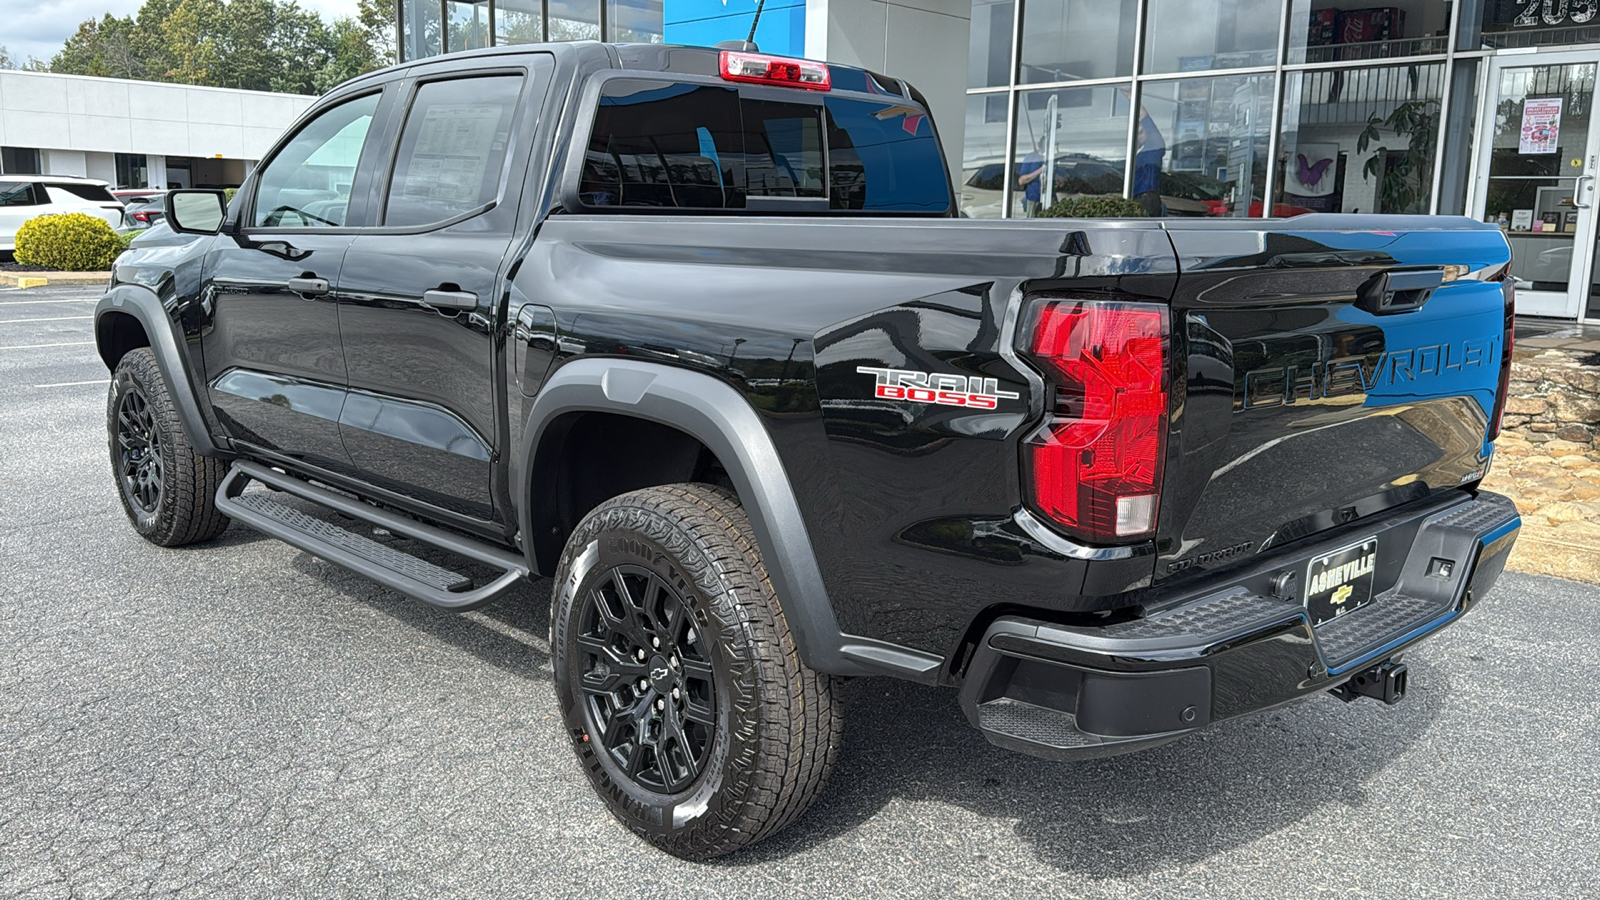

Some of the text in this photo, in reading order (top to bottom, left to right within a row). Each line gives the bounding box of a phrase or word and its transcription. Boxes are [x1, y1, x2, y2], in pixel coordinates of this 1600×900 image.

[856, 366, 1019, 400] TRAIL
[1244, 334, 1500, 410] CHEVROLET
[875, 385, 998, 410] BOSS
[1167, 541, 1254, 573] COLORADO
[1309, 553, 1375, 596] ASHEVILLE
